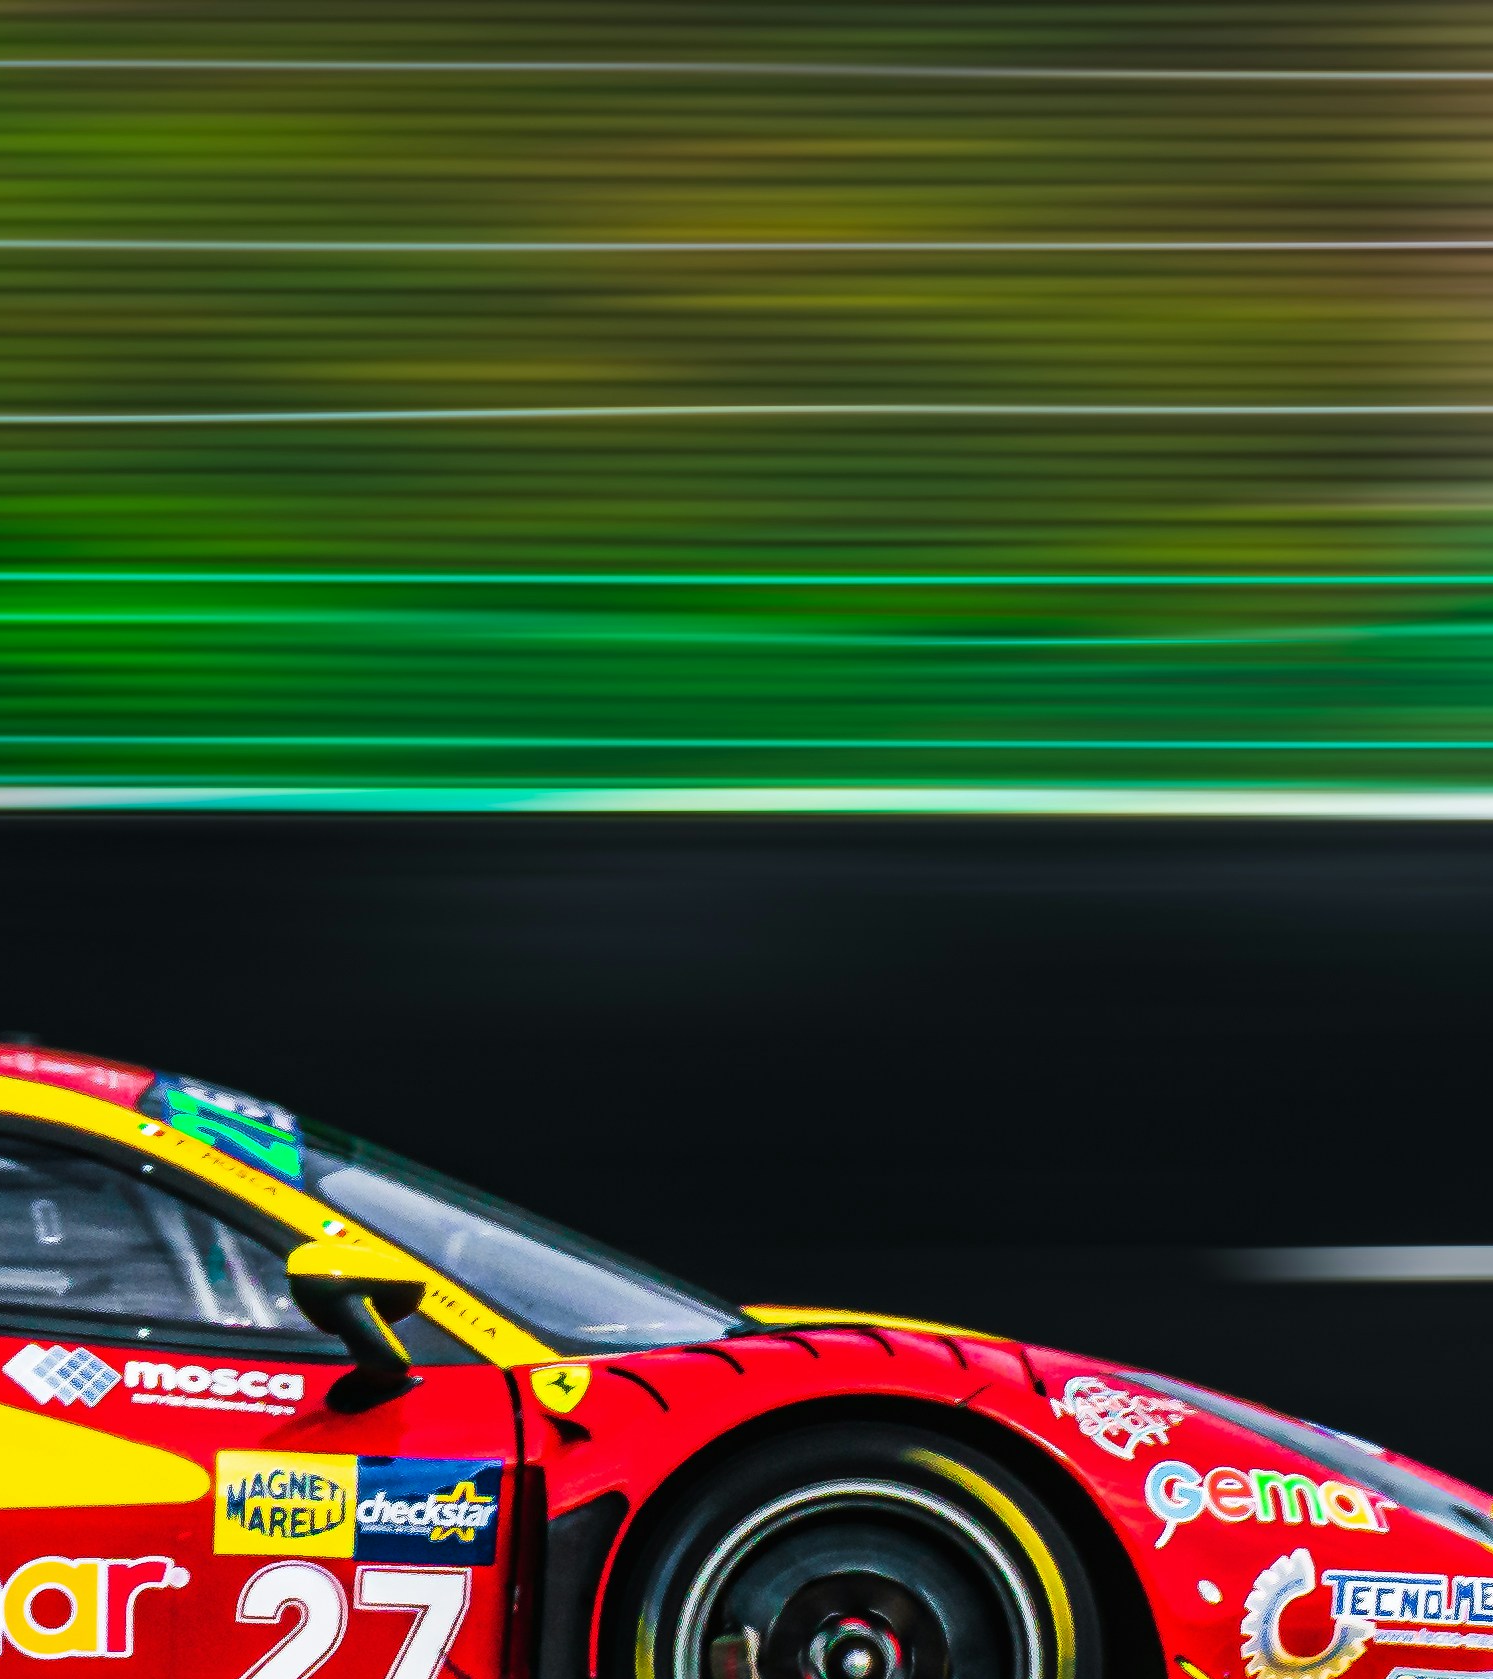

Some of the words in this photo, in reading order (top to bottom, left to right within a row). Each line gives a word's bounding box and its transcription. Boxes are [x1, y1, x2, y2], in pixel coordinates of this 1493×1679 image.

[123, 1361, 305, 1401] mosca
[355, 1490, 497, 1527] checkstar
[1145, 1459, 1397, 1549] Gemar
